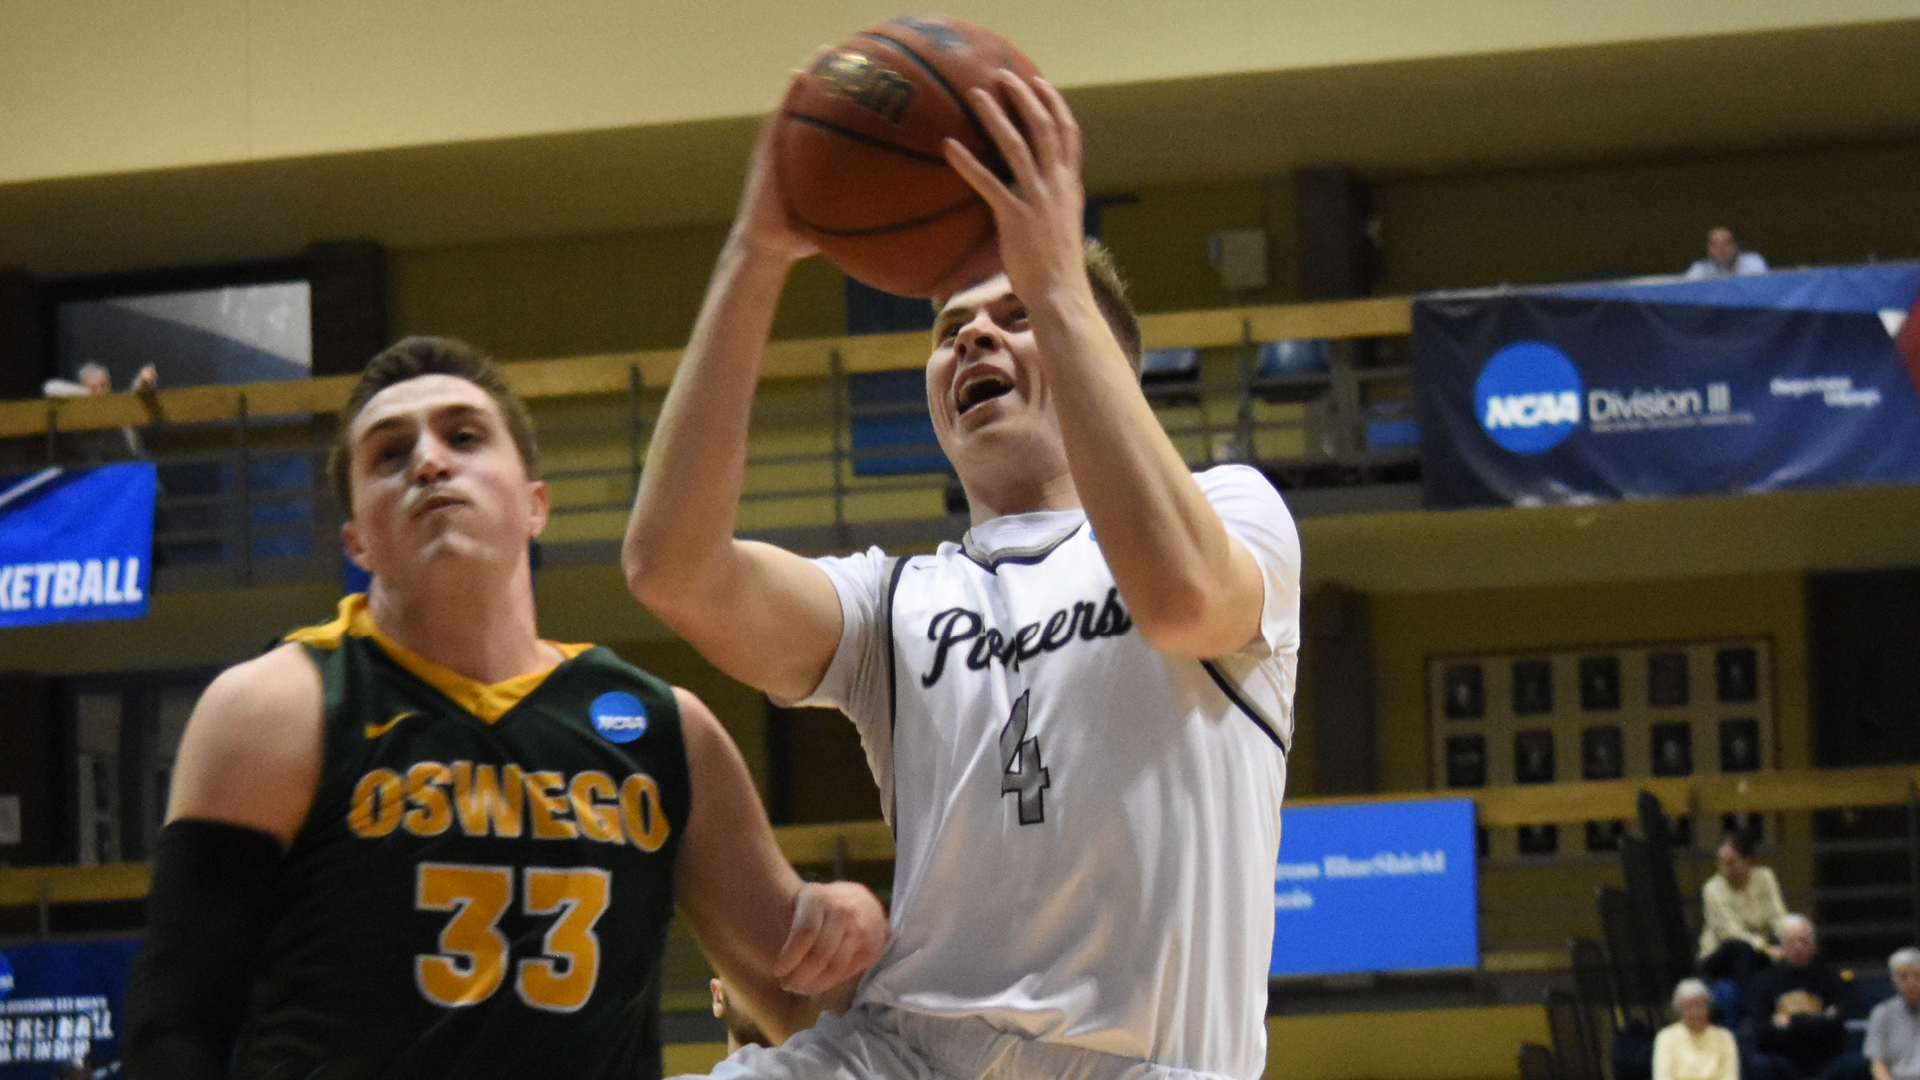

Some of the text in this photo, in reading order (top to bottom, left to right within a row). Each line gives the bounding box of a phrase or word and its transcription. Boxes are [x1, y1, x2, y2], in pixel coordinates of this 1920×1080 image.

[1485, 391, 1581, 430] NCAA
[1588, 388, 1702, 423] Division
[1706, 381, 1731, 414] III
[597, 714, 647, 732] NCAA
[1000, 688, 1050, 826] 4
[347, 760, 671, 852] OSWEGO
[415, 862, 612, 1013] 33
